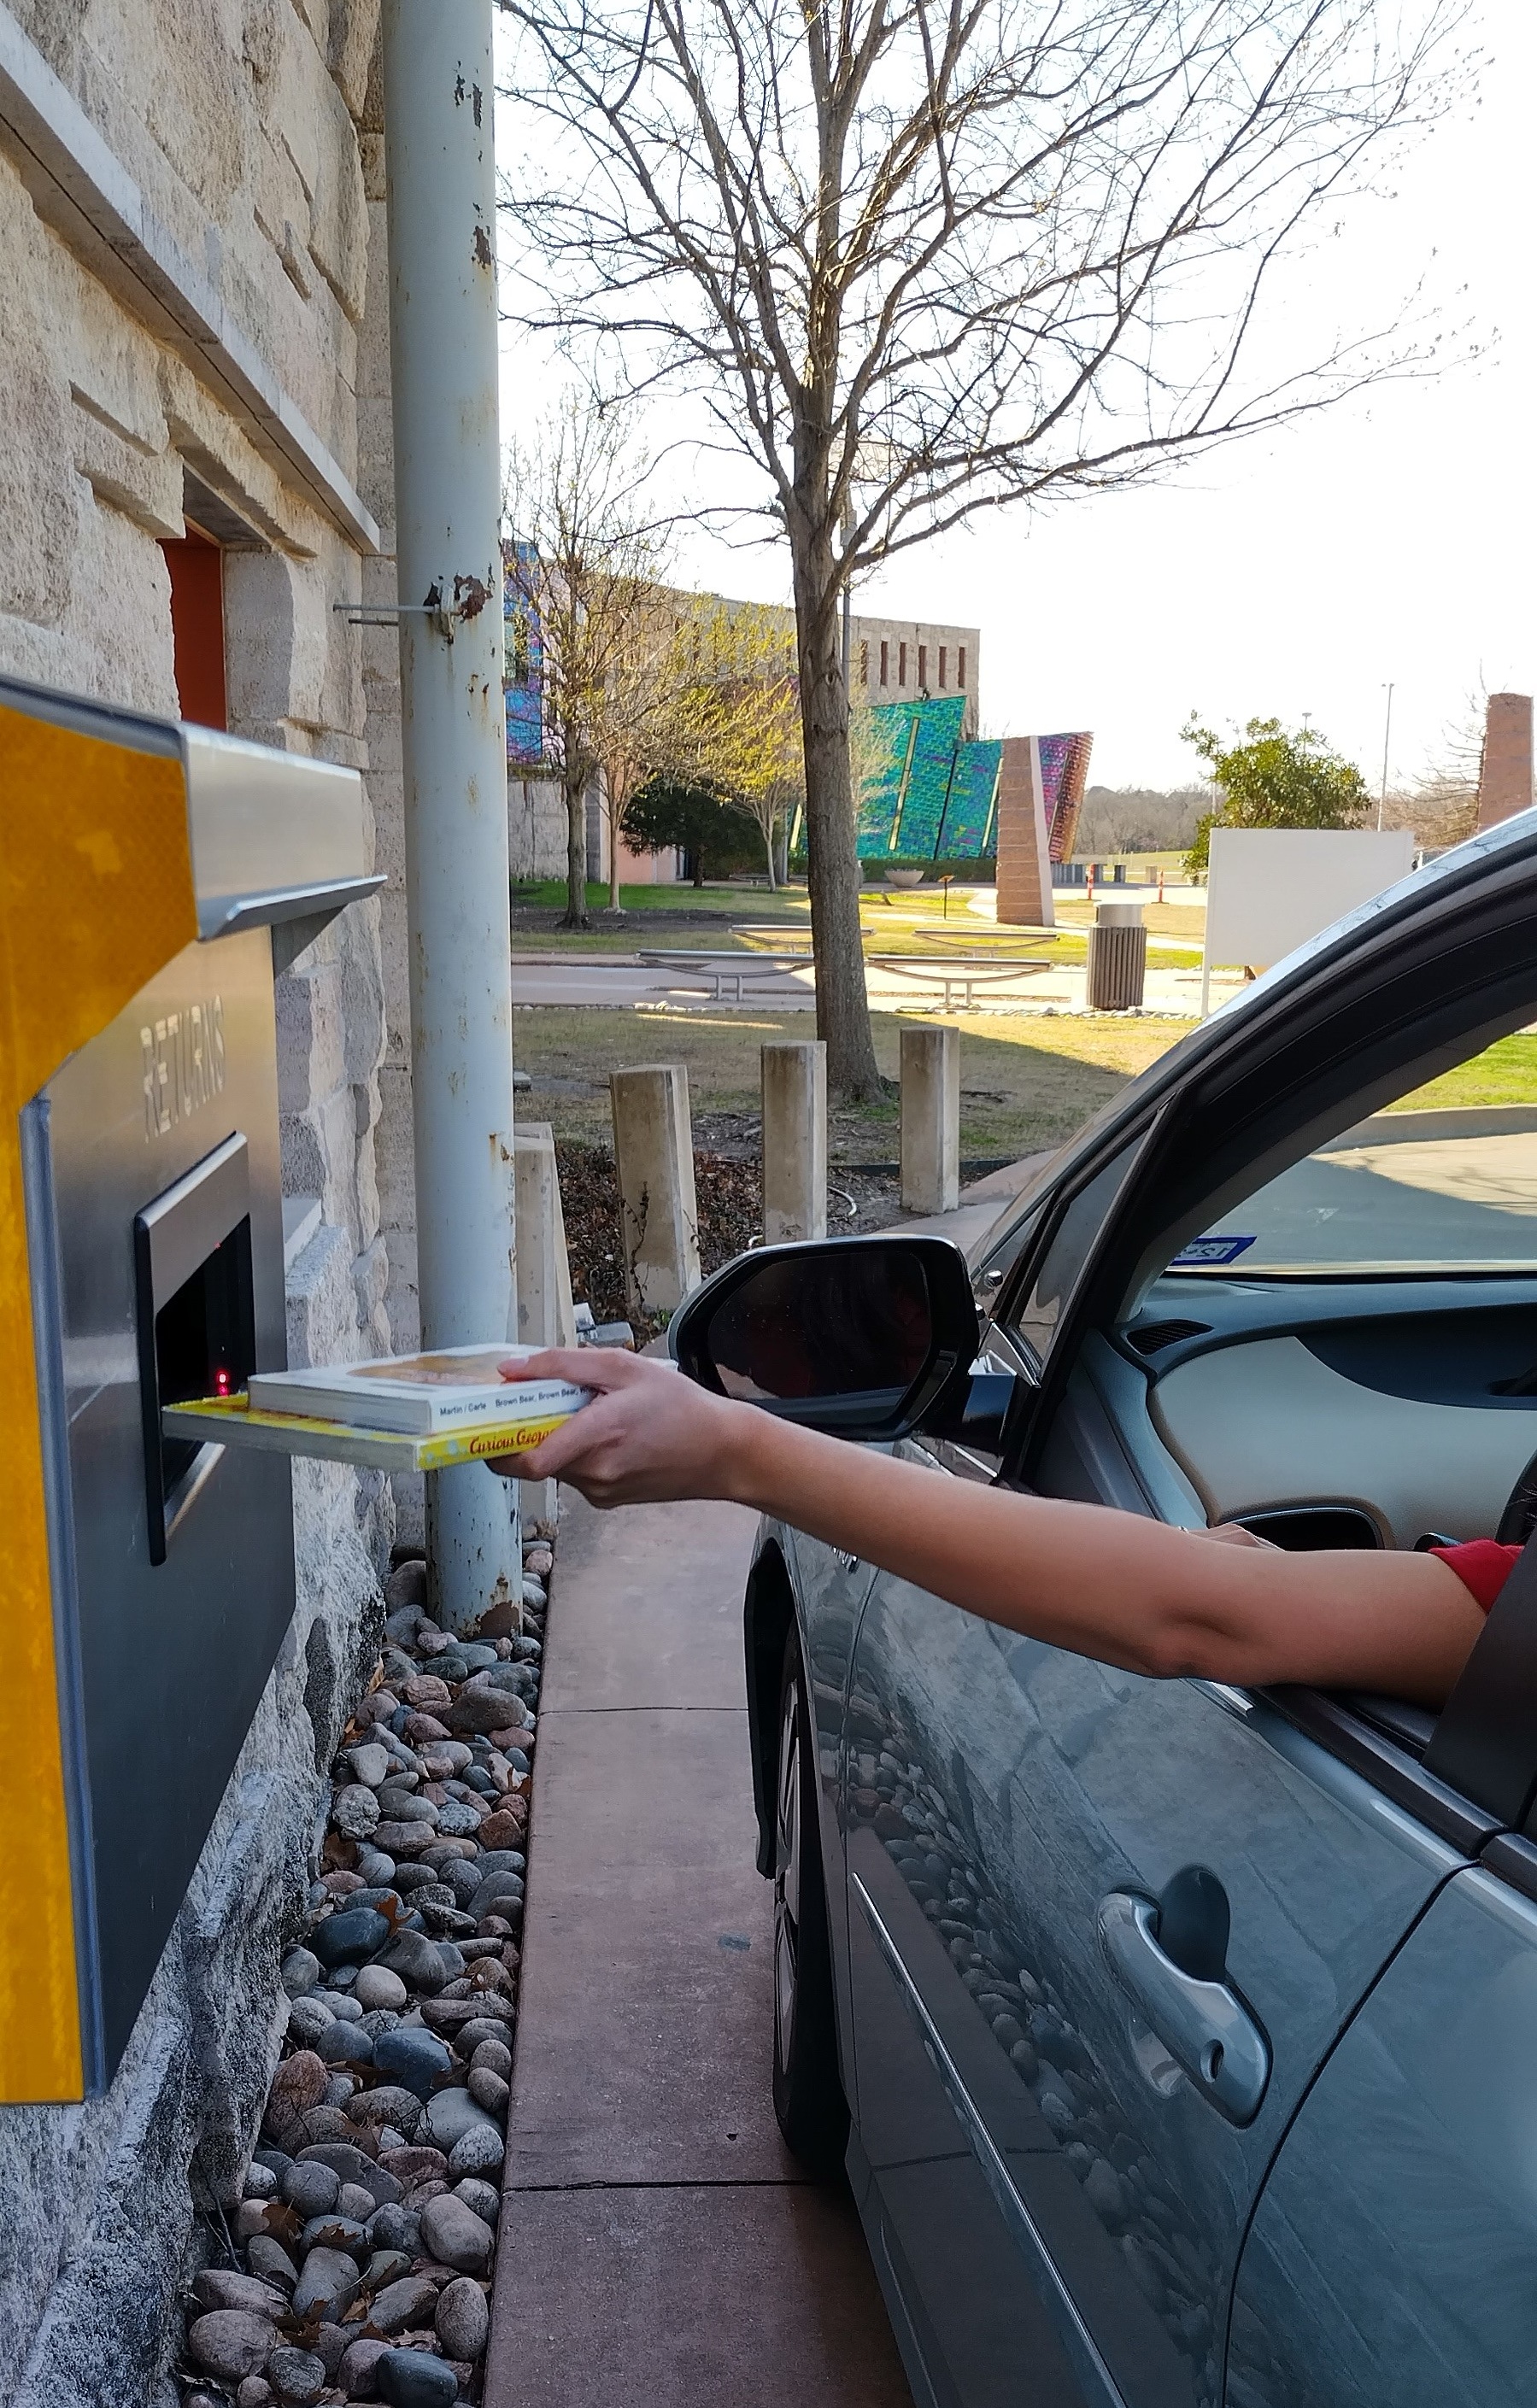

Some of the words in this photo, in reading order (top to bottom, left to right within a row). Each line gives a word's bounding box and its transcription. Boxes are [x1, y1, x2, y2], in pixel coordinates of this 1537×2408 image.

[140, 995, 225, 1143] RETURNS
[440, 1404, 463, 1415] Martin
[468, 1403, 486, 1413] Carle
[496, 1398, 517, 1408] Brown
[519, 1396, 537, 1405] Bear,
[538, 1391, 560, 1400] Brown
[469, 1436, 515, 1455] Curious
[516, 1428, 555, 1447] Georg
